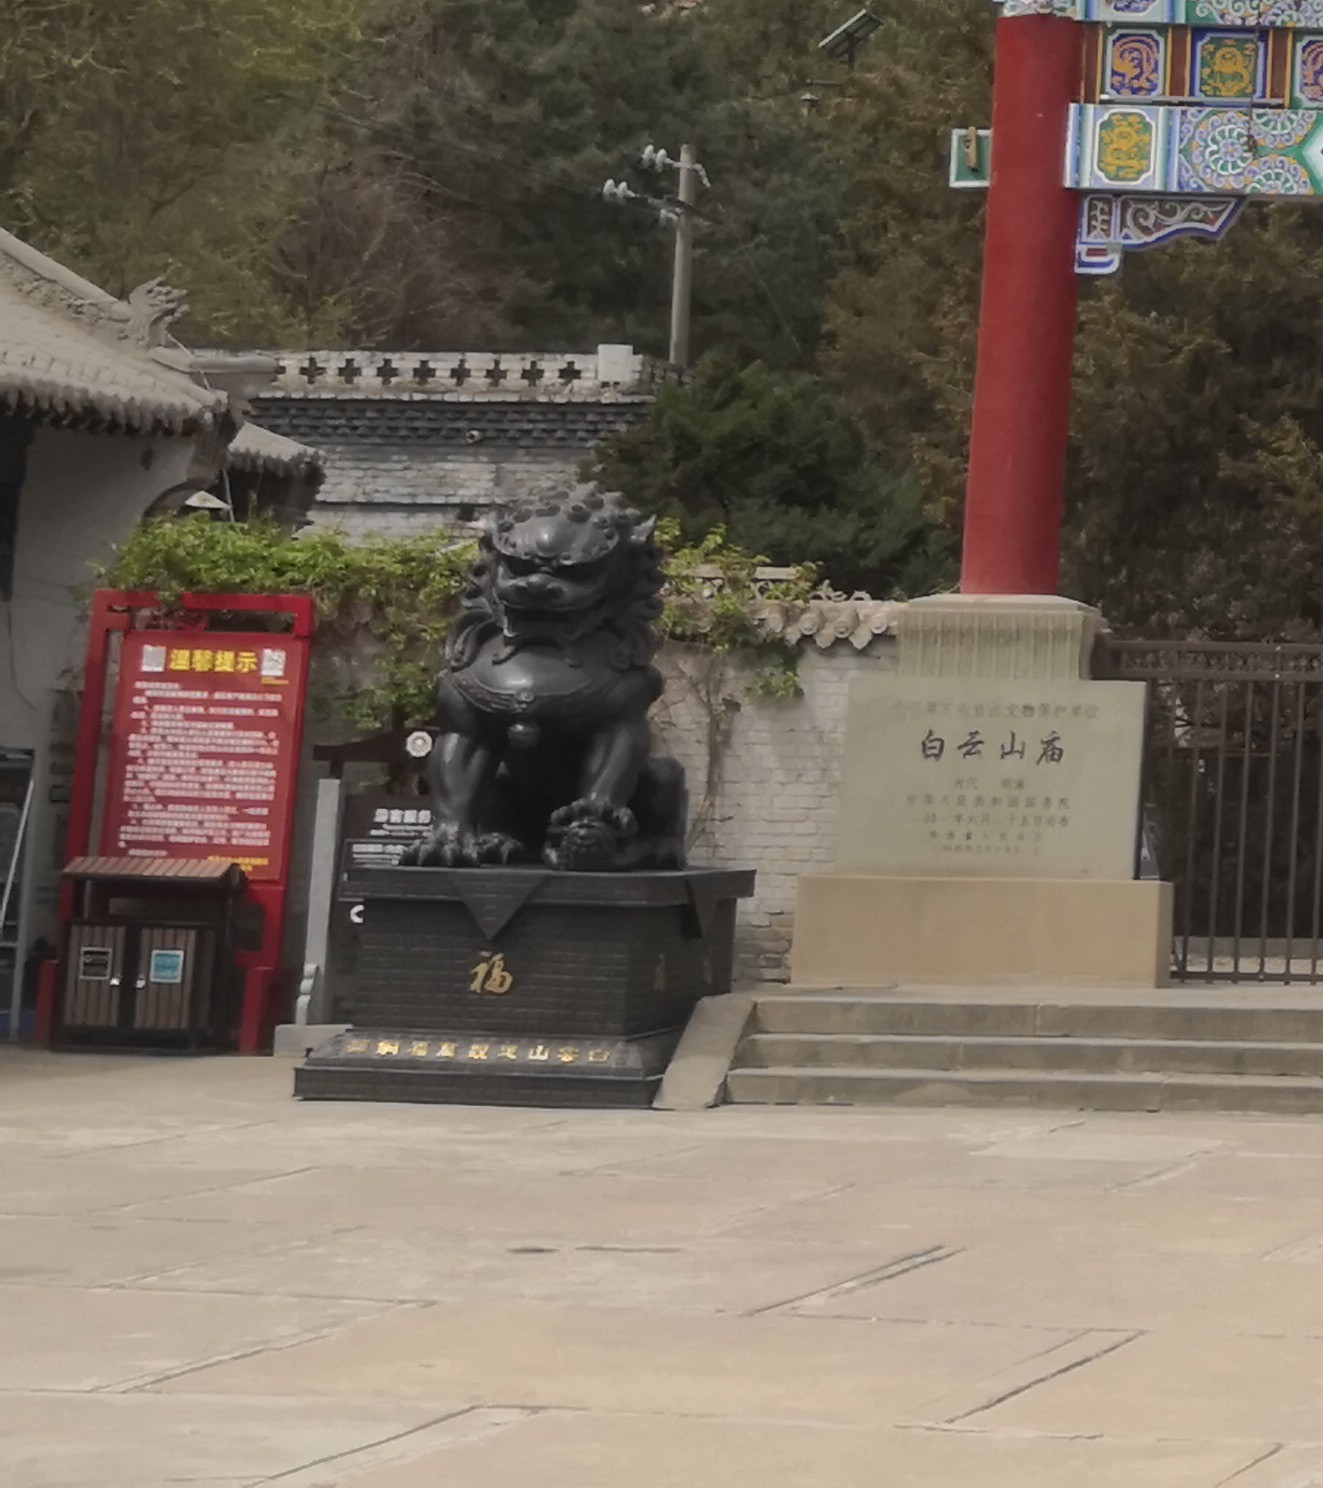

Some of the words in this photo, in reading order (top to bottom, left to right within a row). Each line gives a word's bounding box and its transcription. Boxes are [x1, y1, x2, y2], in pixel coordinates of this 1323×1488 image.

[169, 648, 259, 674] 温馨提示
[920, 729, 1065, 766] 白云山庙
[469, 950, 515, 994] 福
